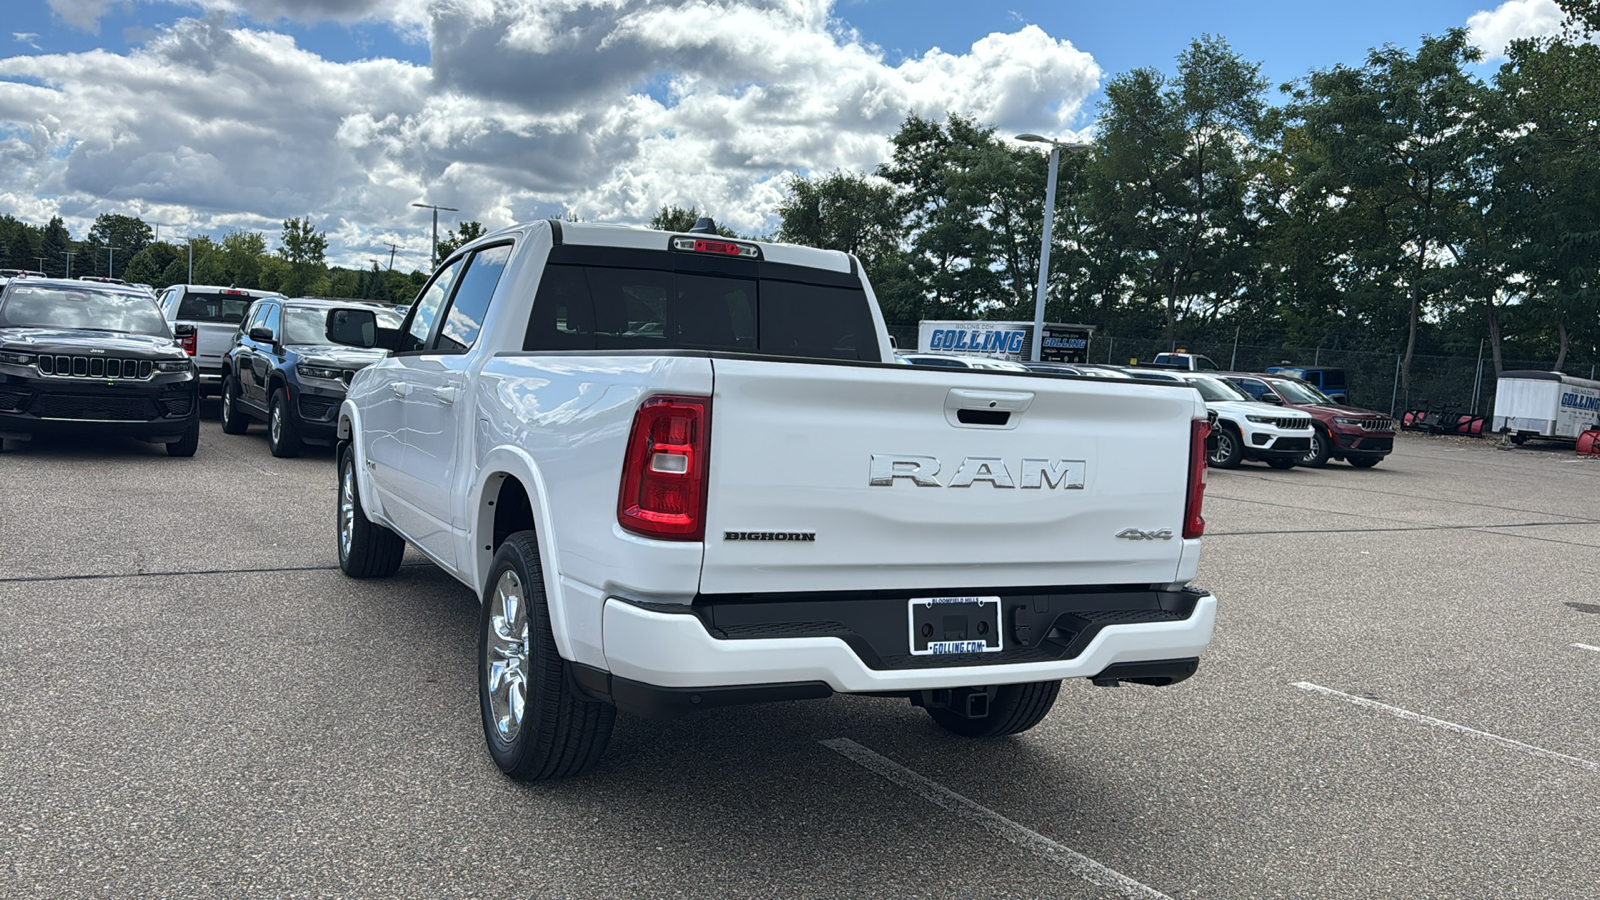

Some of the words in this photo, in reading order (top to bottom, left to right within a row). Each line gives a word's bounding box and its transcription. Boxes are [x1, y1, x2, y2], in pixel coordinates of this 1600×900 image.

[930, 329, 1027, 353] GOLLING
[1043, 337, 1086, 348] GOLLING
[1561, 392, 1600, 412] GOLLING
[869, 454, 1088, 490] RAM
[723, 531, 816, 542] BIGHORN
[933, 641, 983, 654] GOLLING.COM
